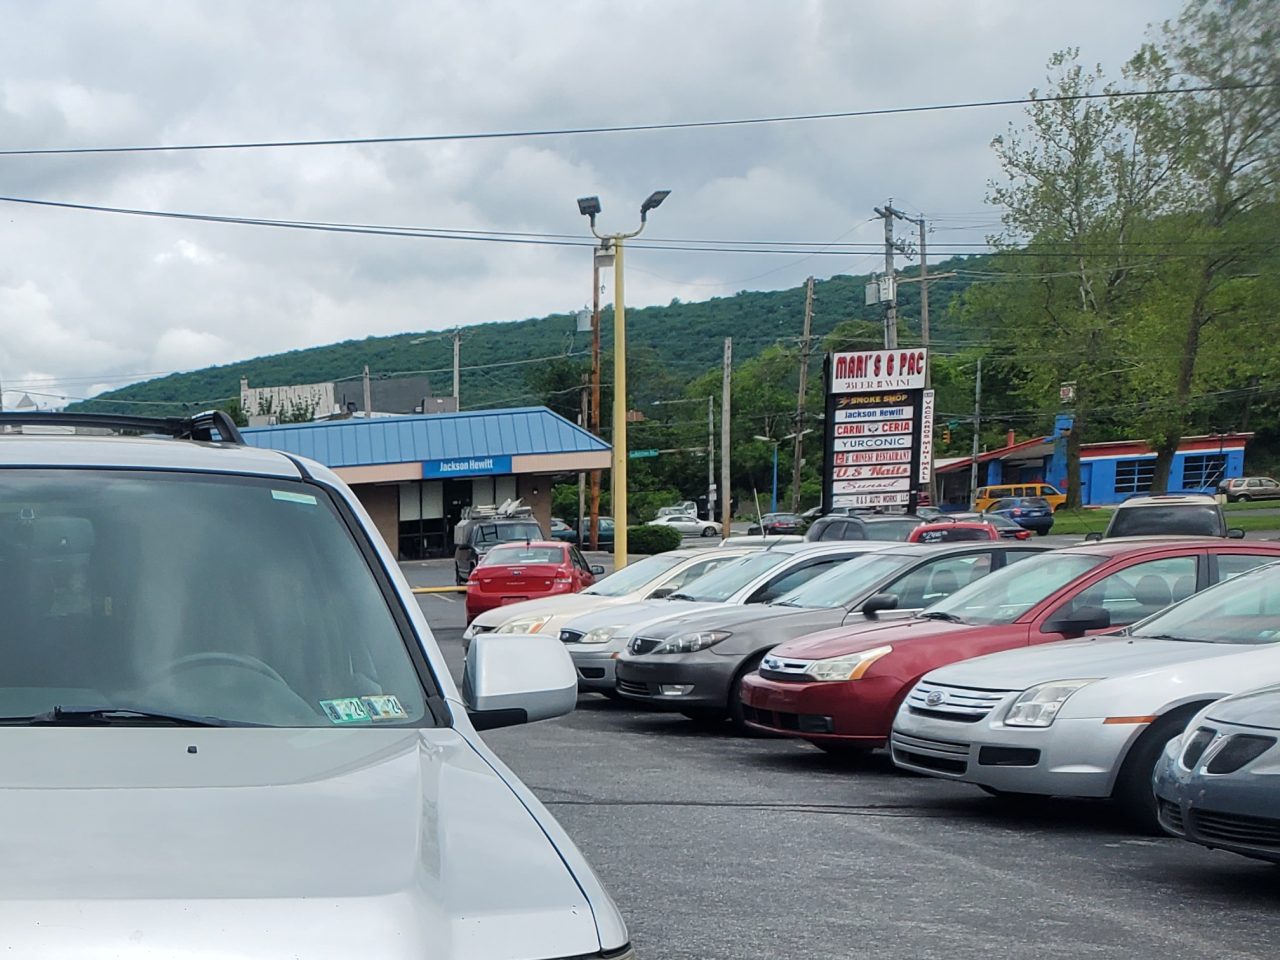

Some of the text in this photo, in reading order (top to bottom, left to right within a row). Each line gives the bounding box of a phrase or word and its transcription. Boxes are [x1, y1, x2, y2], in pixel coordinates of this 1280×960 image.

[898, 351, 925, 376] PAC
[850, 393, 908, 405] SMOKE SHOP
[844, 408, 904, 419] Jackson Hewitt
[836, 421, 910, 435] CARNI CERIA
[841, 437, 905, 448] YURCONIC
[875, 450, 910, 461] RESTAURANT
[440, 459, 493, 471] Jackson Hewitt
[869, 465, 908, 477] Nails
